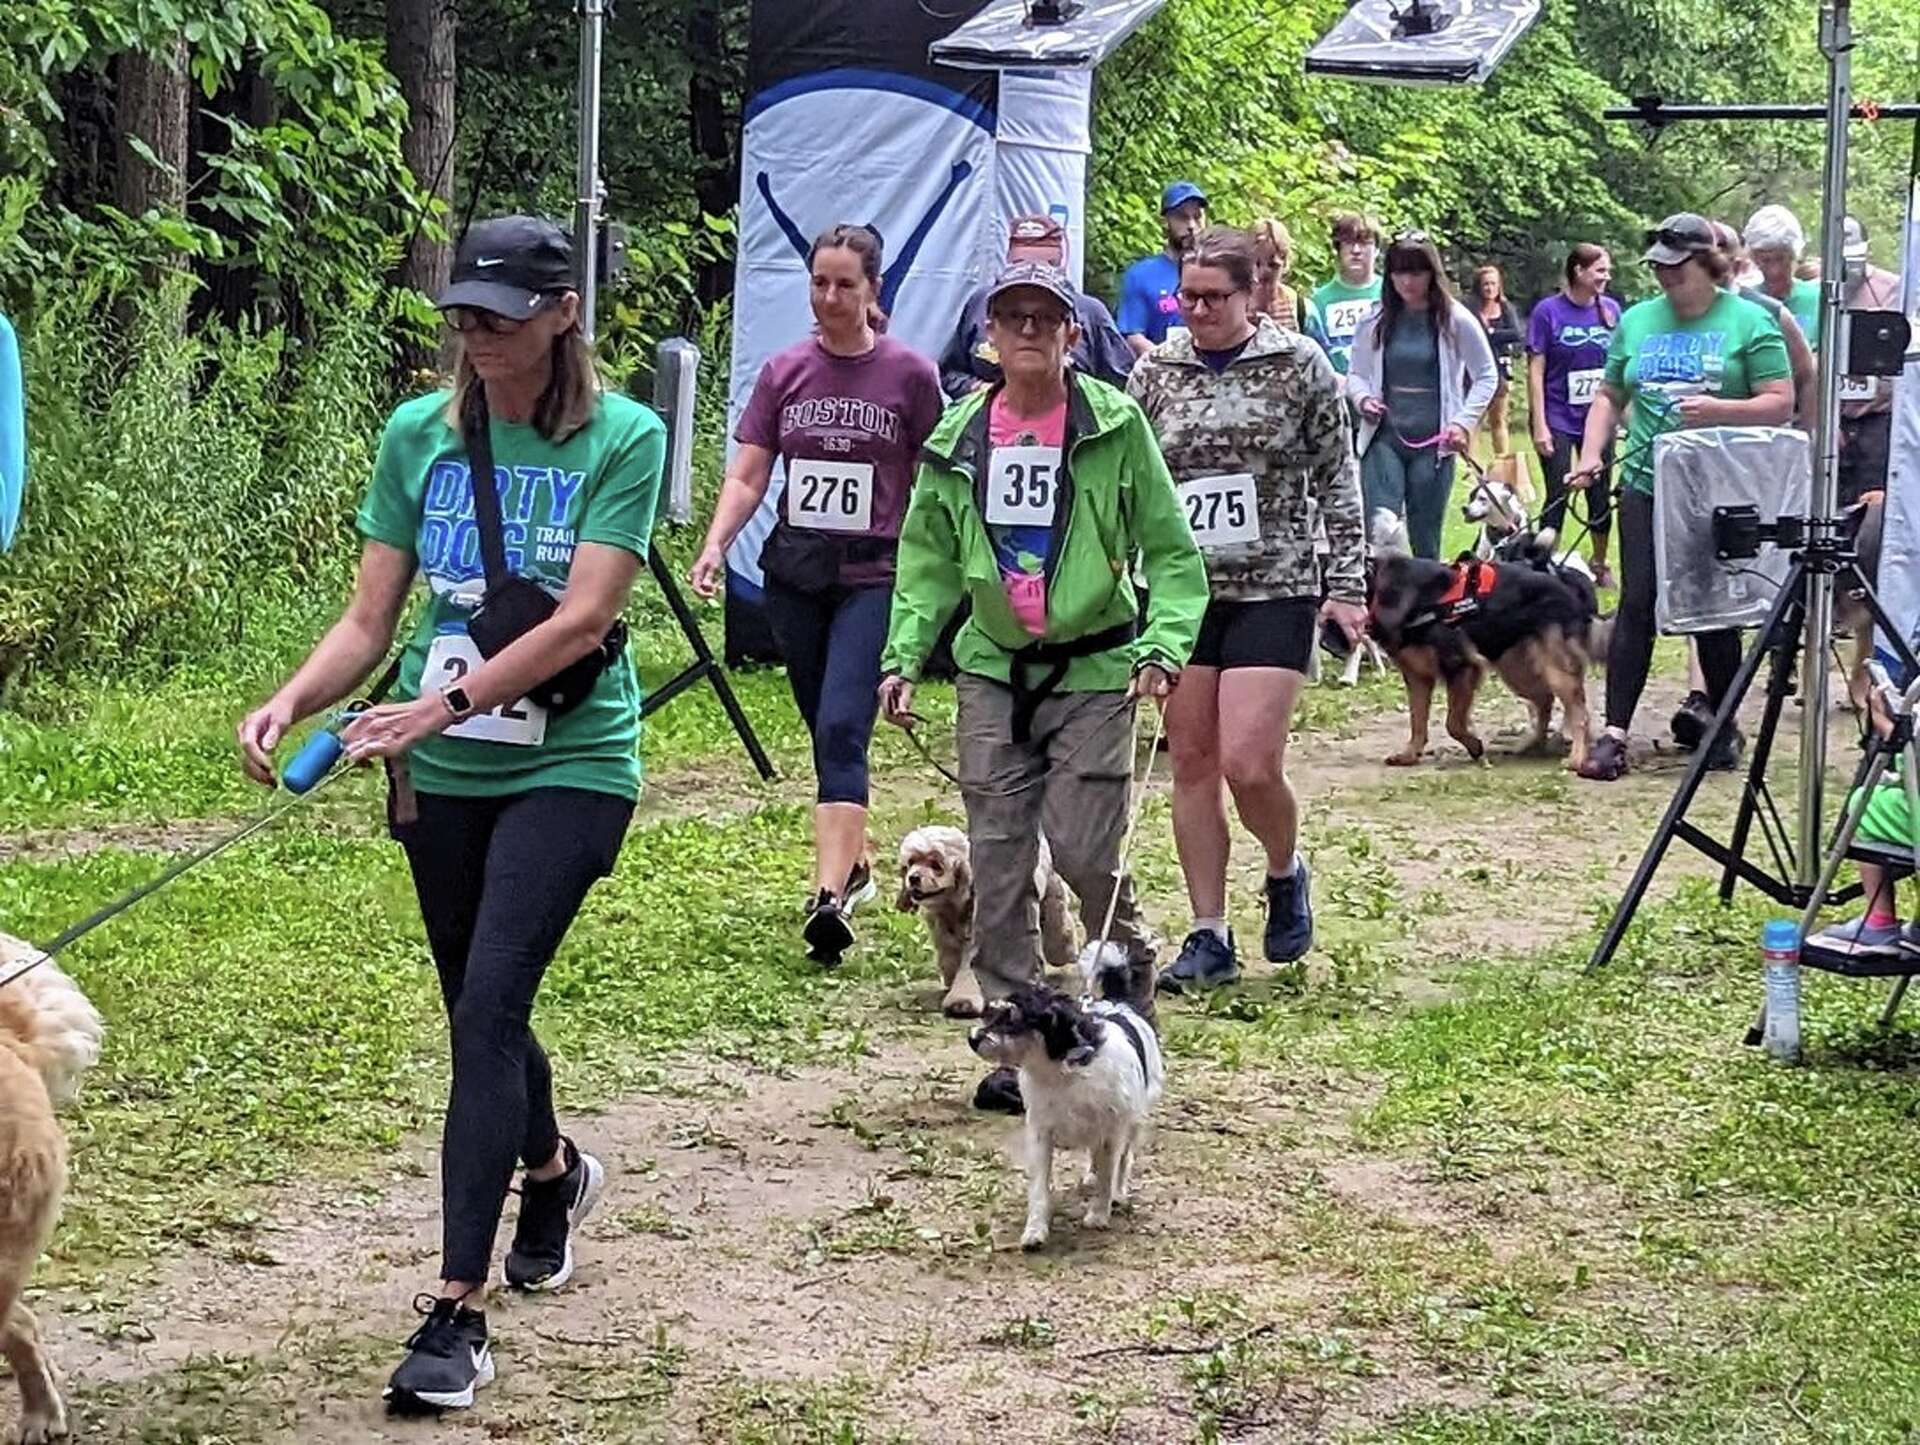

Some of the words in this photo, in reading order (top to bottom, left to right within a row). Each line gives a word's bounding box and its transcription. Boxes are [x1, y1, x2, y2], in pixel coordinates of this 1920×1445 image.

[1334, 307, 1364, 328] 25
[1575, 377, 1602, 396] 27
[781, 397, 901, 443] BOSTON
[799, 474, 860, 515] 276
[1185, 489, 1247, 531] 275
[536, 525, 577, 545] TRAIL
[536, 544, 573, 563] RUN
